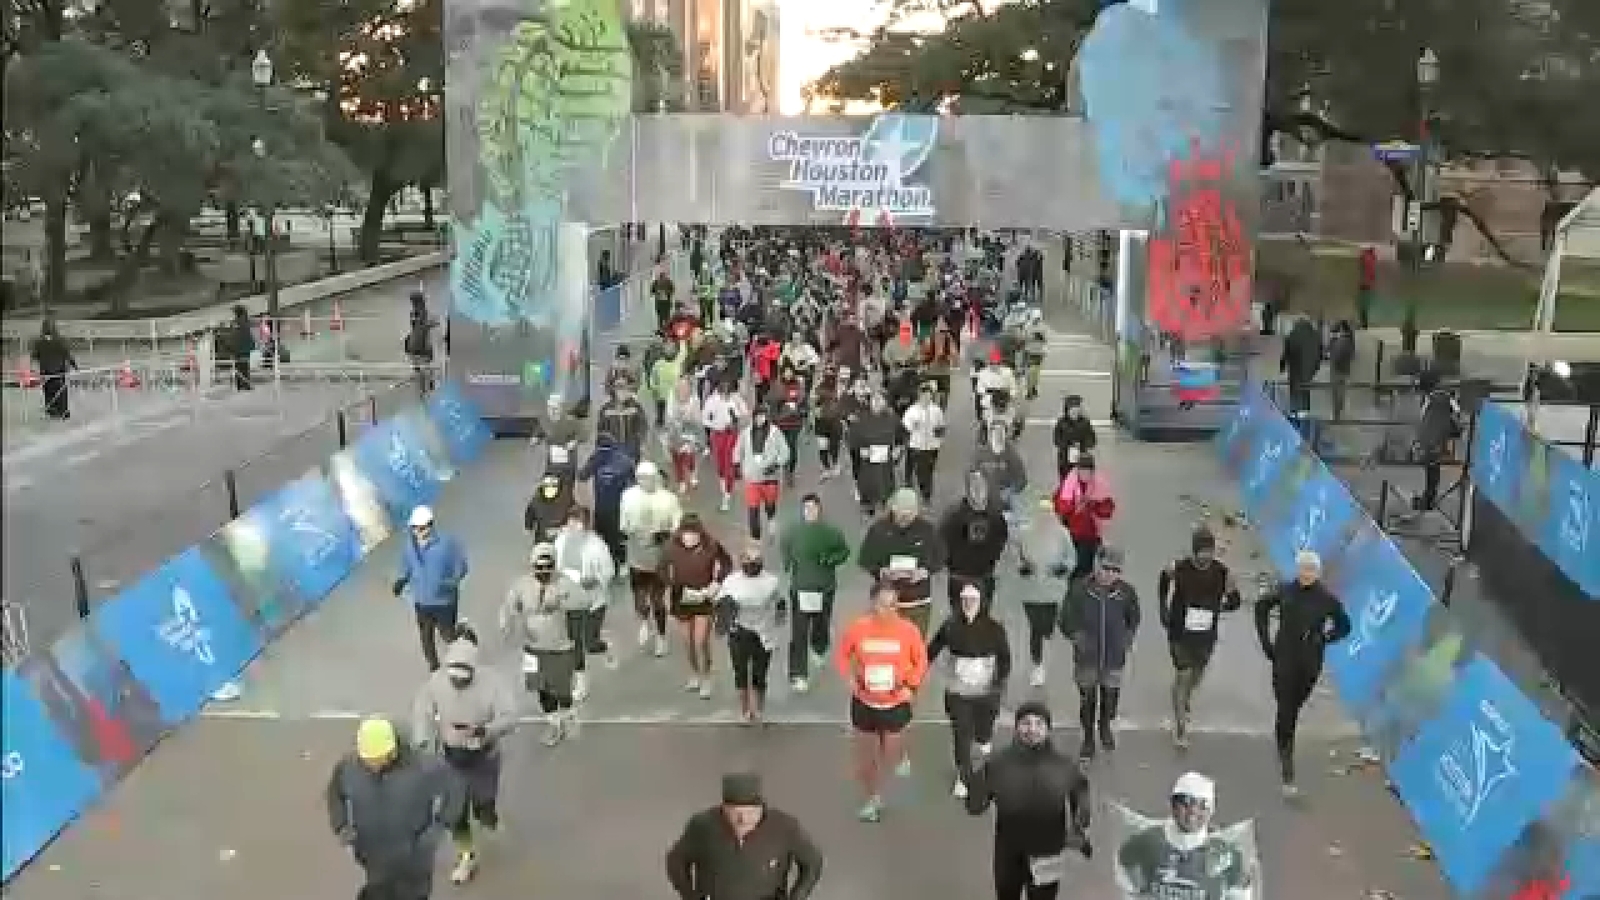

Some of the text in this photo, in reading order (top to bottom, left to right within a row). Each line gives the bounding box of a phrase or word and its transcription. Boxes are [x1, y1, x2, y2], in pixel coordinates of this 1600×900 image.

[771, 132, 861, 158] Chevron
[792, 159, 889, 181] Houston
[817, 184, 932, 207] Marathon
